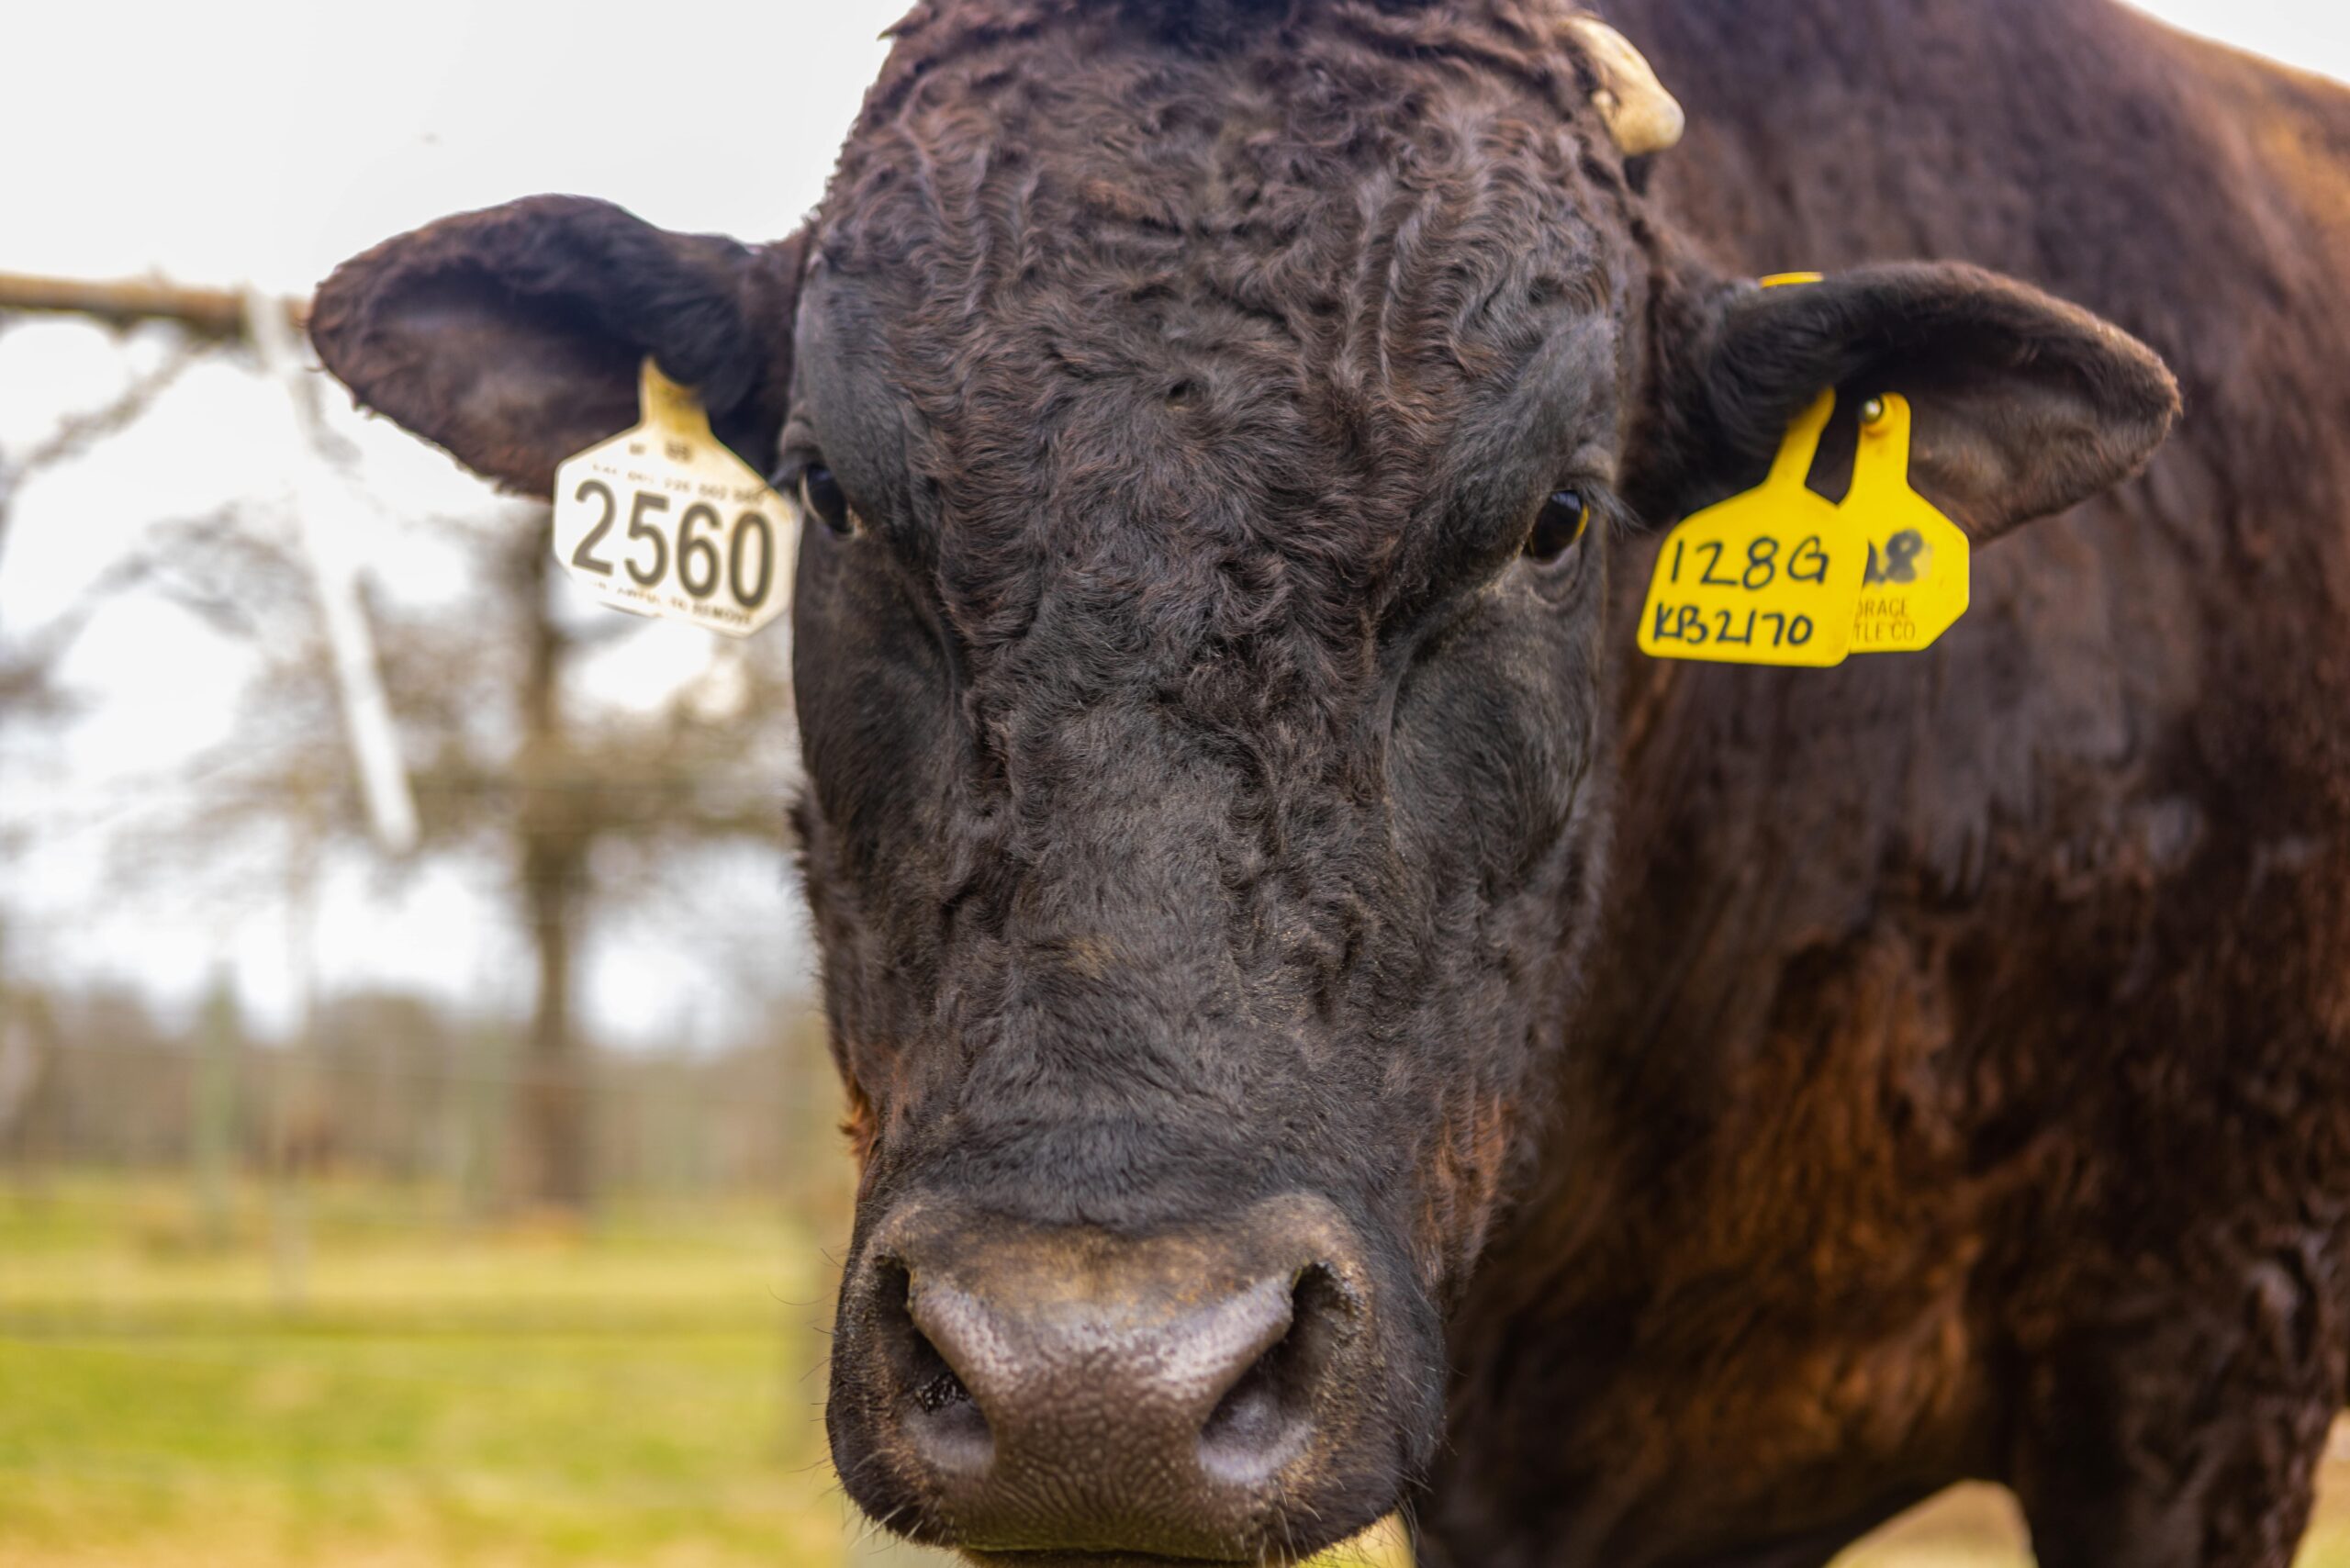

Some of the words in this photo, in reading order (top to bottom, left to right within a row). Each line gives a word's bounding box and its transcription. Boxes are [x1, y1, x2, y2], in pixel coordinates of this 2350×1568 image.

[571, 478, 775, 609] 2560
[1671, 534, 1830, 591] 128G
[1653, 601, 1814, 647] KB2170
